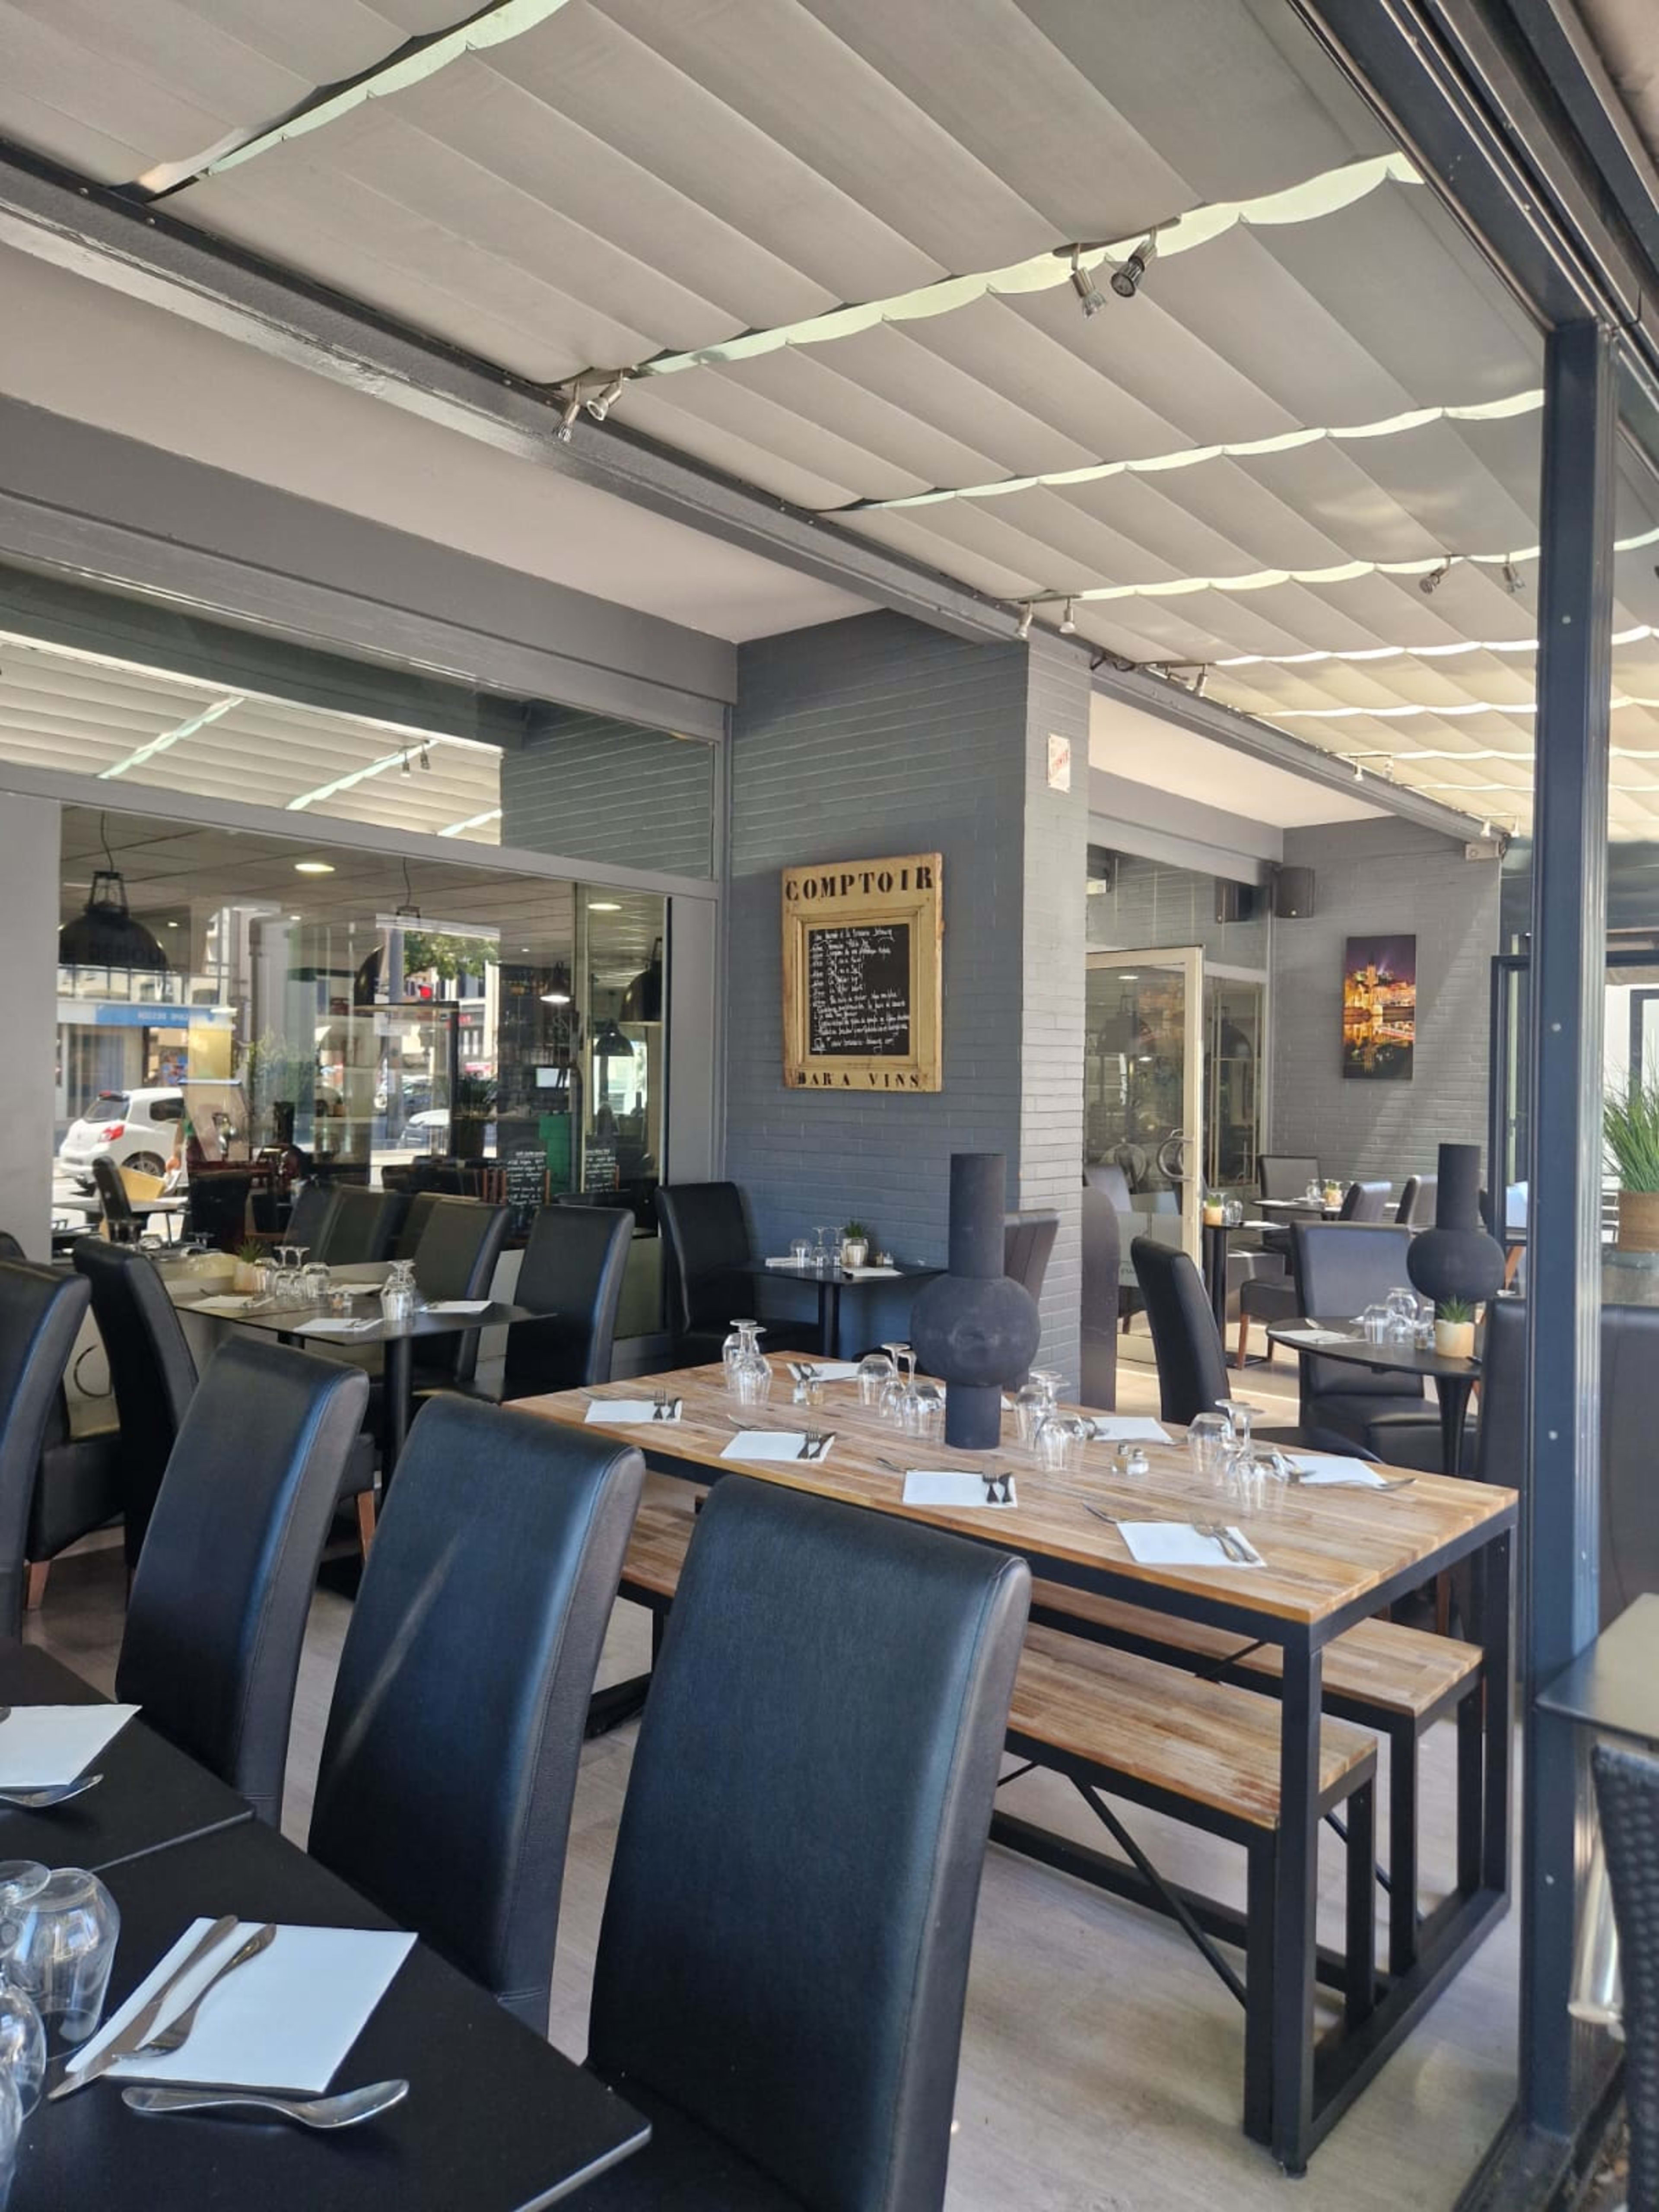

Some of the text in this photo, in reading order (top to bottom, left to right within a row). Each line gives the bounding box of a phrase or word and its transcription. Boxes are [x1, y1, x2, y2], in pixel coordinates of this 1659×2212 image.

[786, 867, 932, 900] COMPTOIR
[798, 1072, 919, 1087] BAR A VINS
